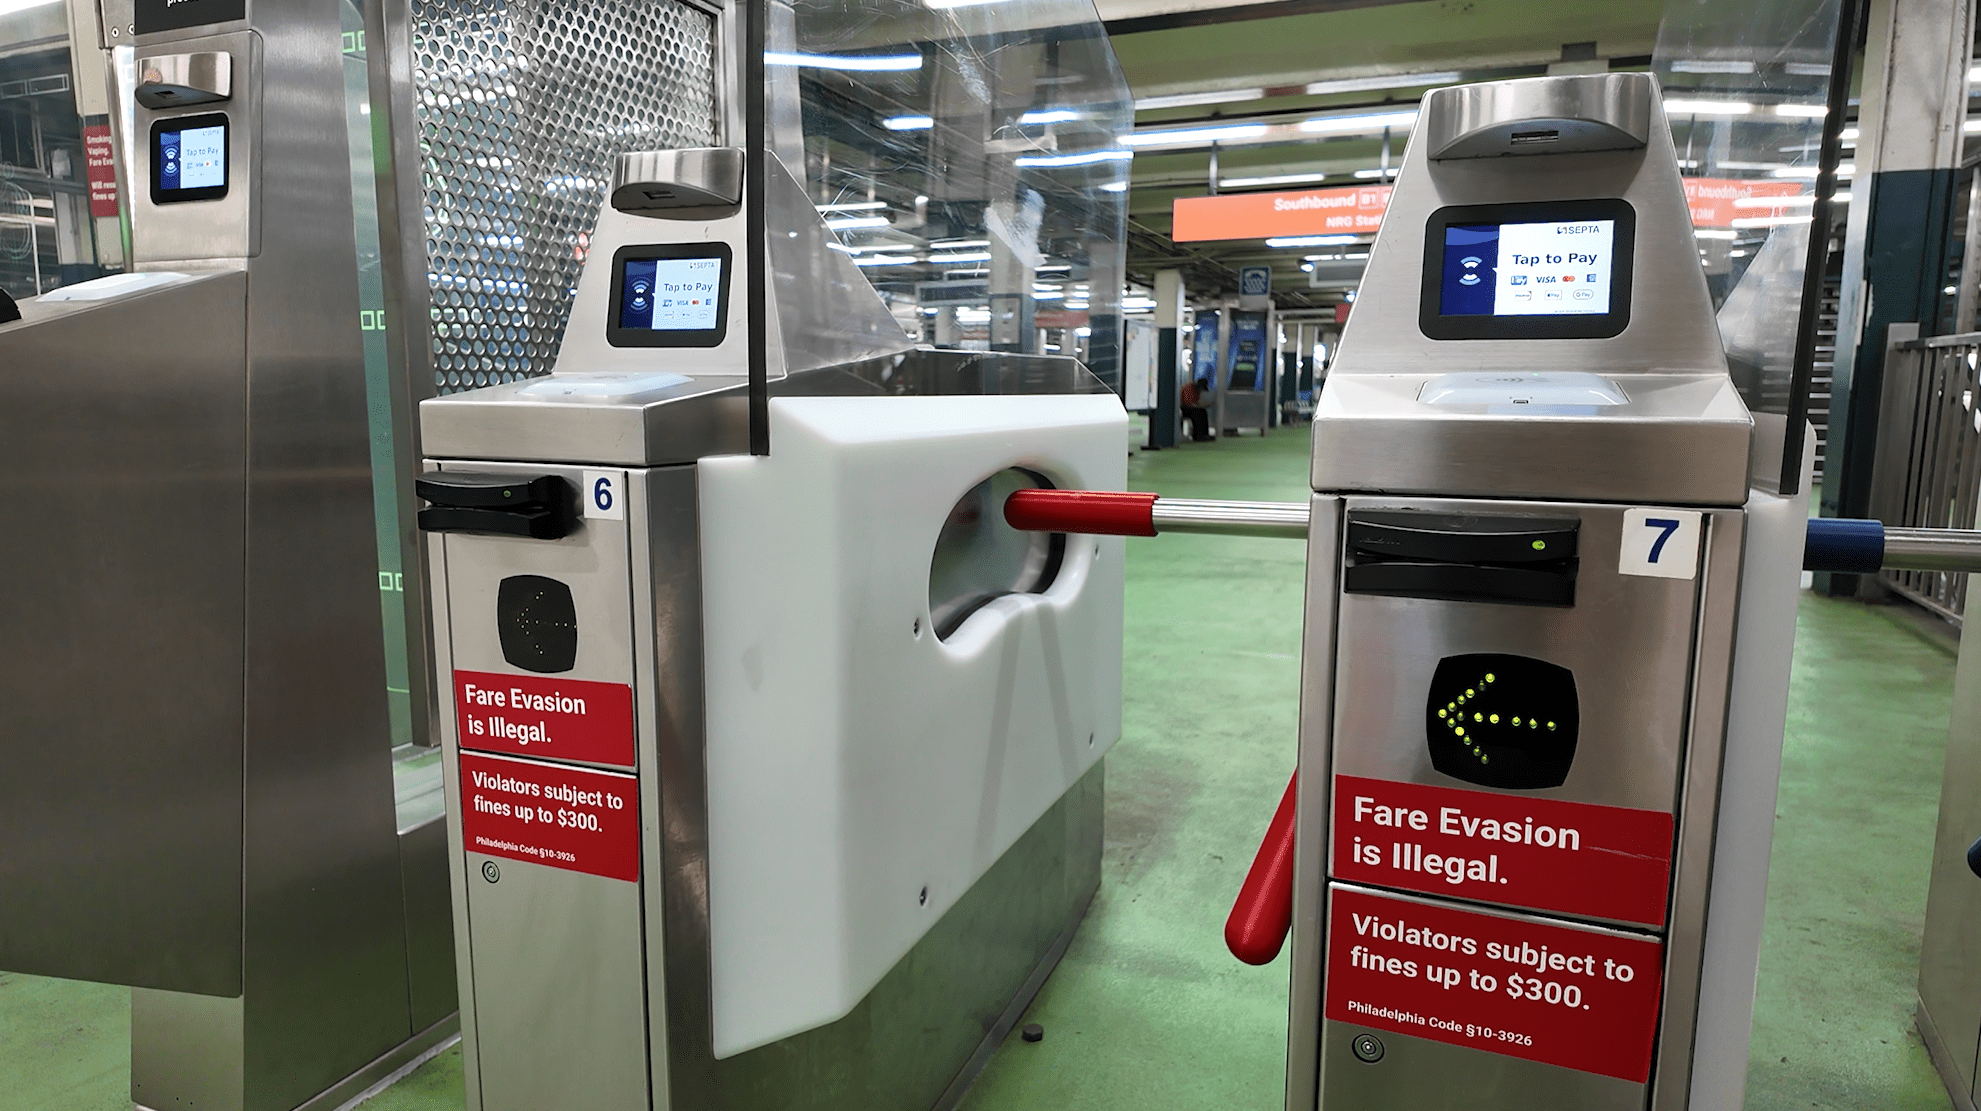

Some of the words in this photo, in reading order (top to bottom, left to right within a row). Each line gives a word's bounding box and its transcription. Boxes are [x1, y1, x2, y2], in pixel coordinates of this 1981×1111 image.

[89, 157, 102, 166] Fare
[207, 147, 219, 155] Pay
[91, 181, 103, 190] Will
[1274, 193, 1356, 211] Southbound
[1326, 215, 1353, 228] NRG
[1568, 226, 1600, 234] SEPTA
[1512, 254, 1540, 267] Tap
[1546, 254, 1562, 264] to
[1568, 253, 1598, 266] Pay
[664, 283, 680, 293] Tap
[683, 283, 693, 291] to
[695, 282, 713, 292] Pay
[594, 477, 613, 511] 6
[1644, 518, 1680, 564] 7
[465, 683, 506, 707] Fare
[510, 687, 586, 715] Evasion
[467, 714, 484, 736] is
[488, 715, 552, 746] Illegal.
[471, 770, 541, 797] Violators
[544, 783, 603, 807] subject
[606, 792, 624, 810] to
[473, 794, 511, 817] fines
[514, 804, 534, 824] up
[537, 806, 554, 824] to
[557, 807, 603, 833] $300.
[1353, 795, 1429, 831] Fare
[1439, 806, 1580, 851] Evasion
[475, 836, 519, 852] Philadelphia
[519, 844, 539, 856] Code
[539, 847, 576, 863] §10-3926
[1352, 836, 1381, 866] is
[1392, 842, 1508, 884] Illegal.
[1351, 912, 1477, 955] Violators
[1485, 940, 1595, 976] subject
[1604, 957, 1635, 983] to
[1350, 945, 1418, 978] fines
[1426, 964, 1461, 990] up
[1469, 968, 1498, 993] to
[1505, 971, 1590, 1011] $300.
[1348, 1000, 1426, 1027] Philadelphia
[1428, 1016, 1463, 1034] Code
[1465, 1023, 1533, 1047] §10-3926
